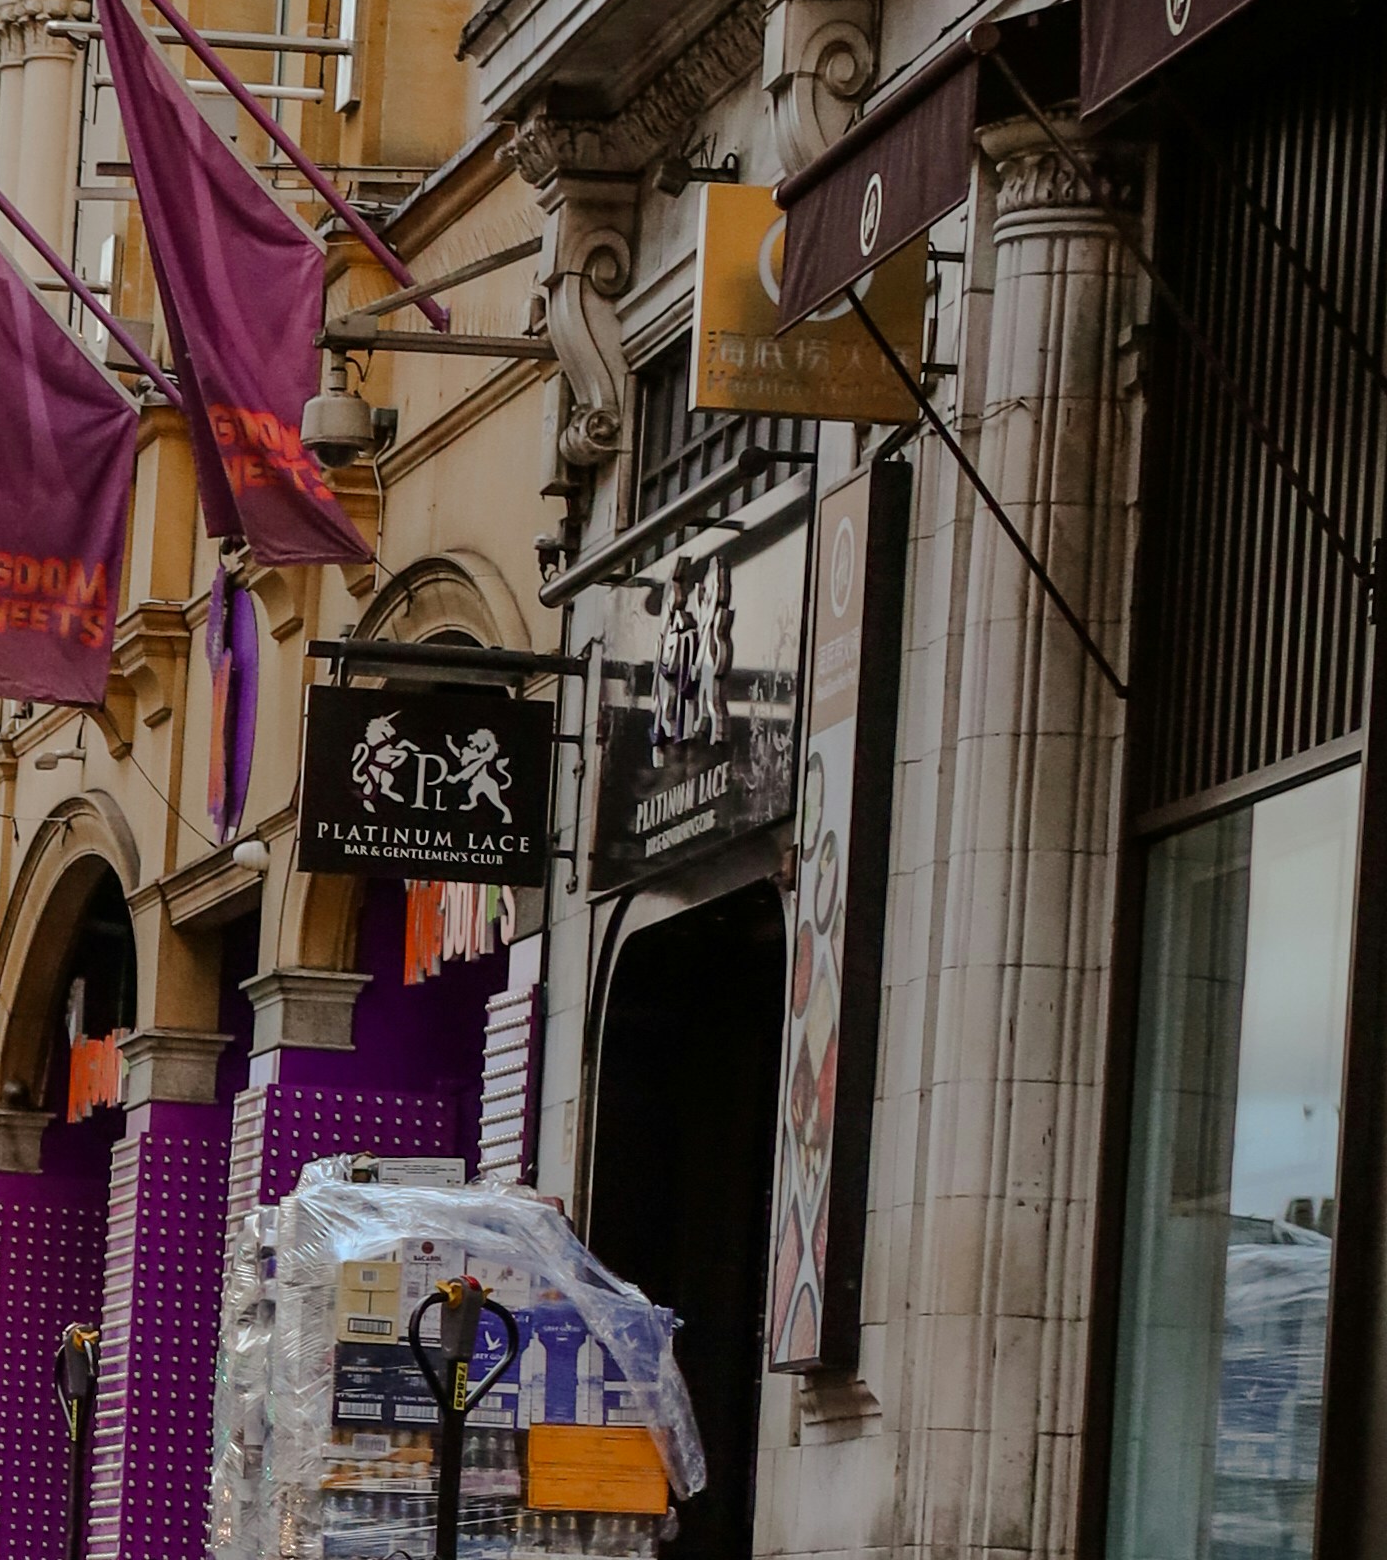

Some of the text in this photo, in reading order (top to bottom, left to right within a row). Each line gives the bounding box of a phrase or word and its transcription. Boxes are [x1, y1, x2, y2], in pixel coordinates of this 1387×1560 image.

[636, 778, 696, 834] PLATINUM
[698, 761, 730, 804] LACE
[317, 822, 531, 853] PLATINUM LACE
[344, 843, 503, 864] BAR & GENTLEMEN'S CLUB
